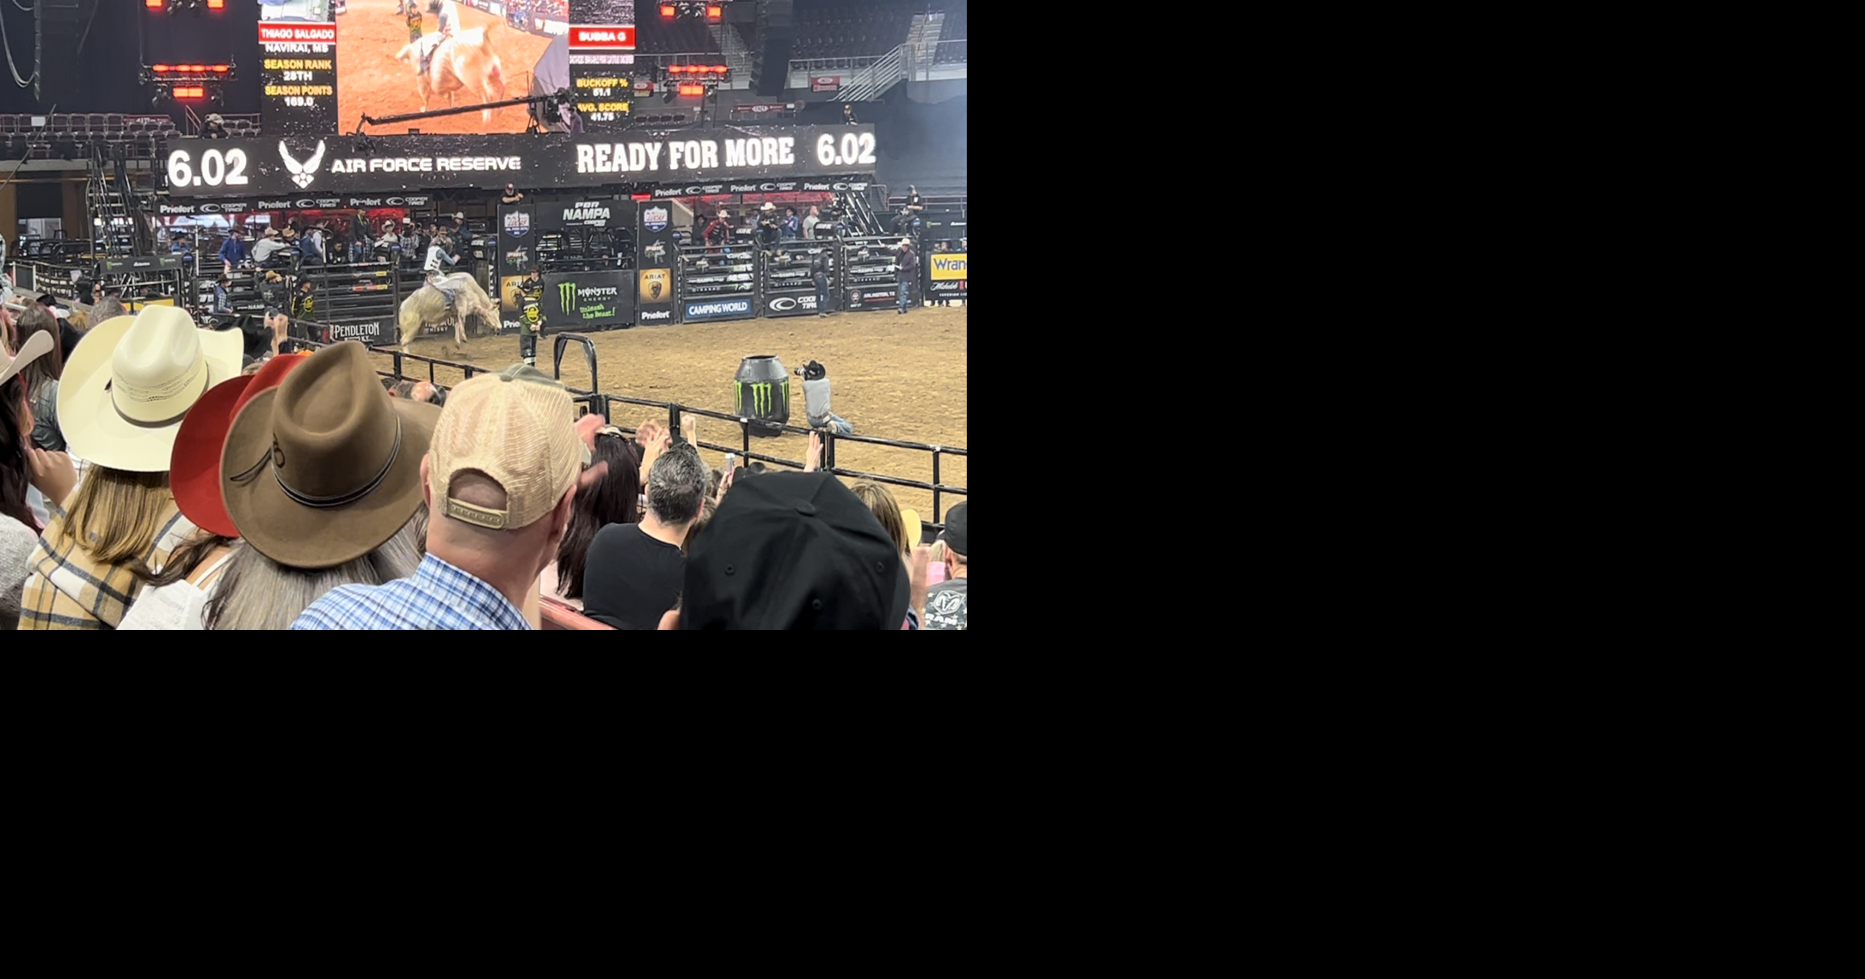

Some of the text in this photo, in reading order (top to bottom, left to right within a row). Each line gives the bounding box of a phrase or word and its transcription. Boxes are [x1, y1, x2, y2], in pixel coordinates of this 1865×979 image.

[261, 28, 335, 39] THIAGO SALGADO
[578, 32, 626, 42] BUBBA G
[312, 44, 329, 53] MS
[264, 59, 332, 70] SEASON RANK
[283, 71, 313, 81] 28TH
[576, 79, 618, 88] BUCKOFF
[264, 85, 333, 95] SEASON POINTS
[284, 96, 314, 106] 169.0
[598, 103, 629, 112] SCORE
[816, 132, 877, 166] 6.02
[576, 136, 795, 173] READY FOR MORE
[167, 148, 249, 188] 6.02
[331, 156, 521, 173] AIR FORCE RESERVE
[730, 184, 757, 192] Priefert
[804, 182, 830, 191] Priefert
[655, 188, 682, 197] Priefert
[258, 200, 291, 209] Priefert
[350, 197, 381, 206] Priefert
[574, 201, 600, 209] PBR
[160, 204, 196, 214] Priefert
[562, 207, 611, 221] NAMPA
[933, 257, 967, 271] Wran
[577, 287, 618, 297] MONSTER
[688, 302, 748, 316] CAMPING WORLD
[641, 310, 671, 320] Priefert
[503, 320, 521, 329] Prie
[334, 322, 380, 339] PENDLETON
[925, 612, 958, 626] RAM
